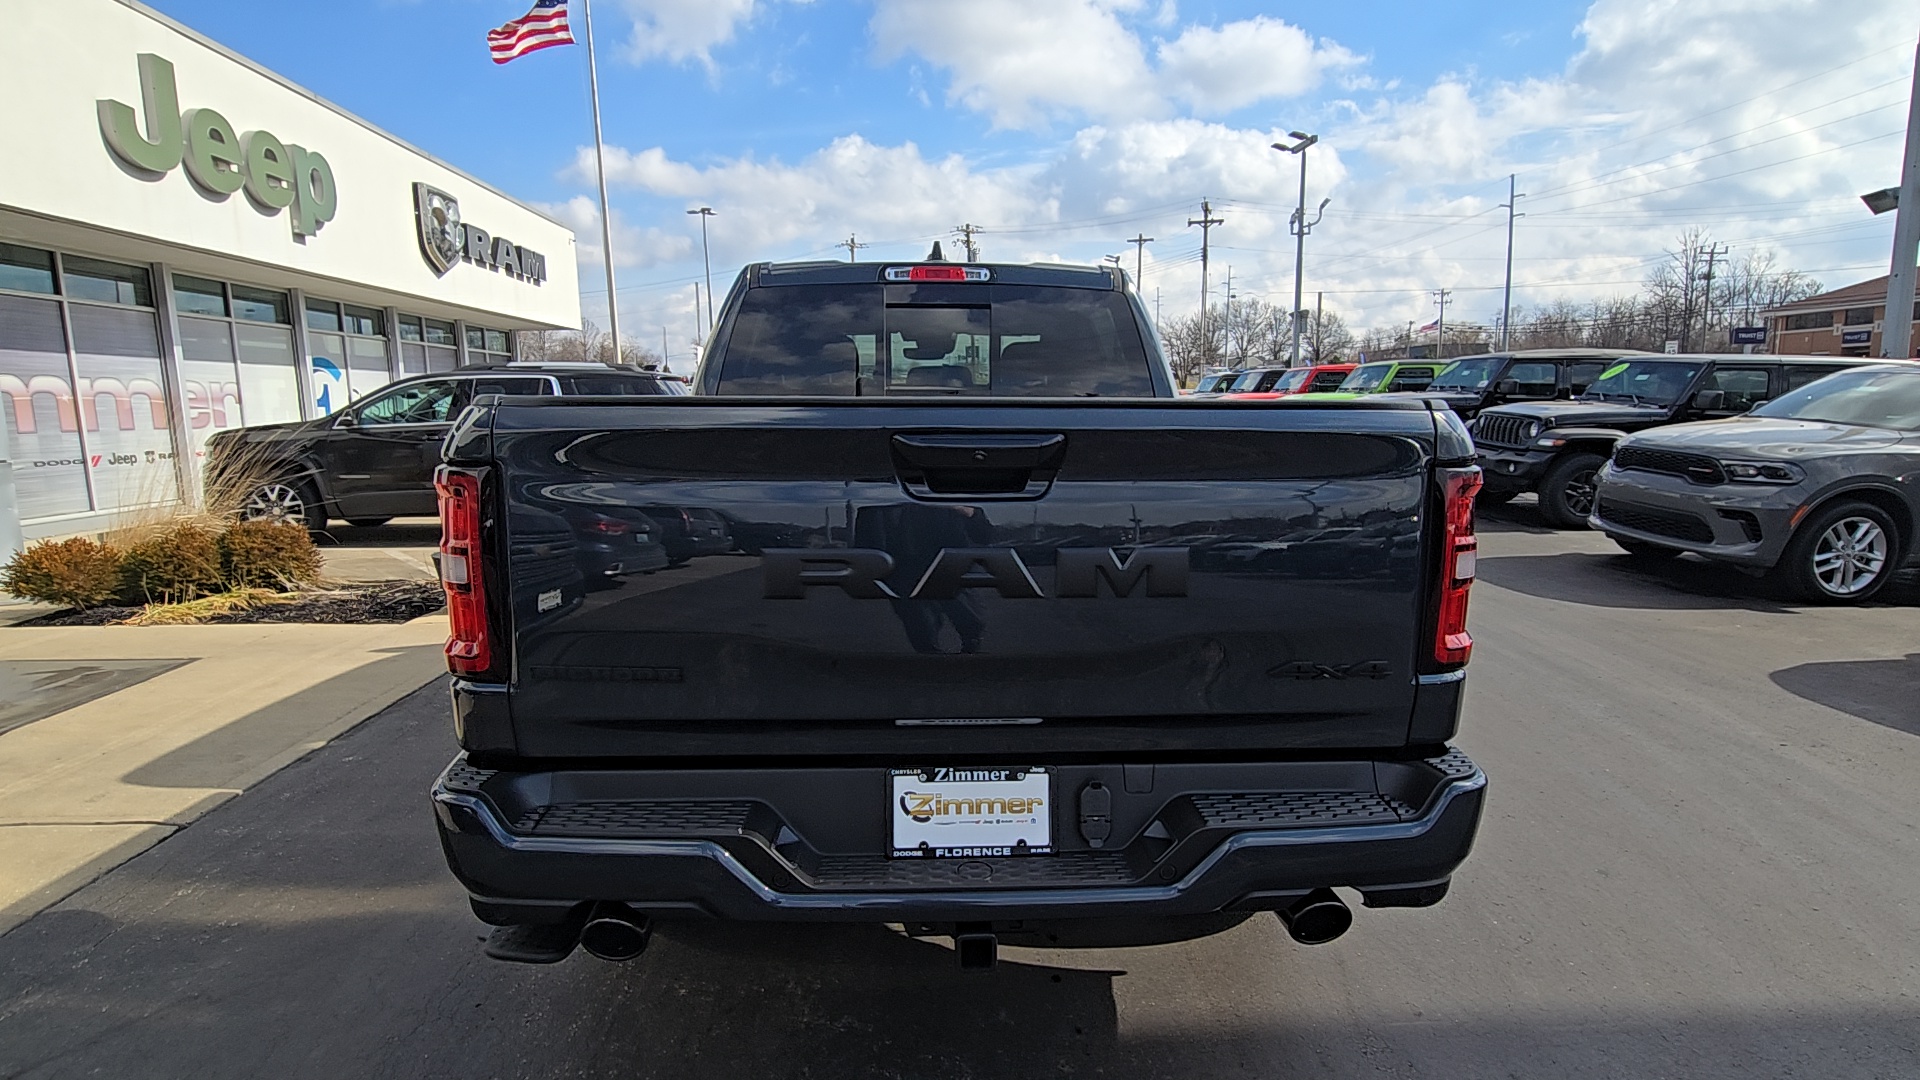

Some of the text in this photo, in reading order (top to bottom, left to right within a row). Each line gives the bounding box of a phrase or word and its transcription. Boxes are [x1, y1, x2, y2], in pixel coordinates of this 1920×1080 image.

[96, 53, 337, 237] Jeep
[463, 223, 547, 282] RAM
[33, 458, 85, 468] DODG
[108, 452, 138, 466] Jeep
[760, 547, 1190, 599] RAM
[933, 767, 1010, 782] Zimmer
[909, 793, 1044, 817] Zimmer
[935, 847, 1012, 858] FLORENCE
